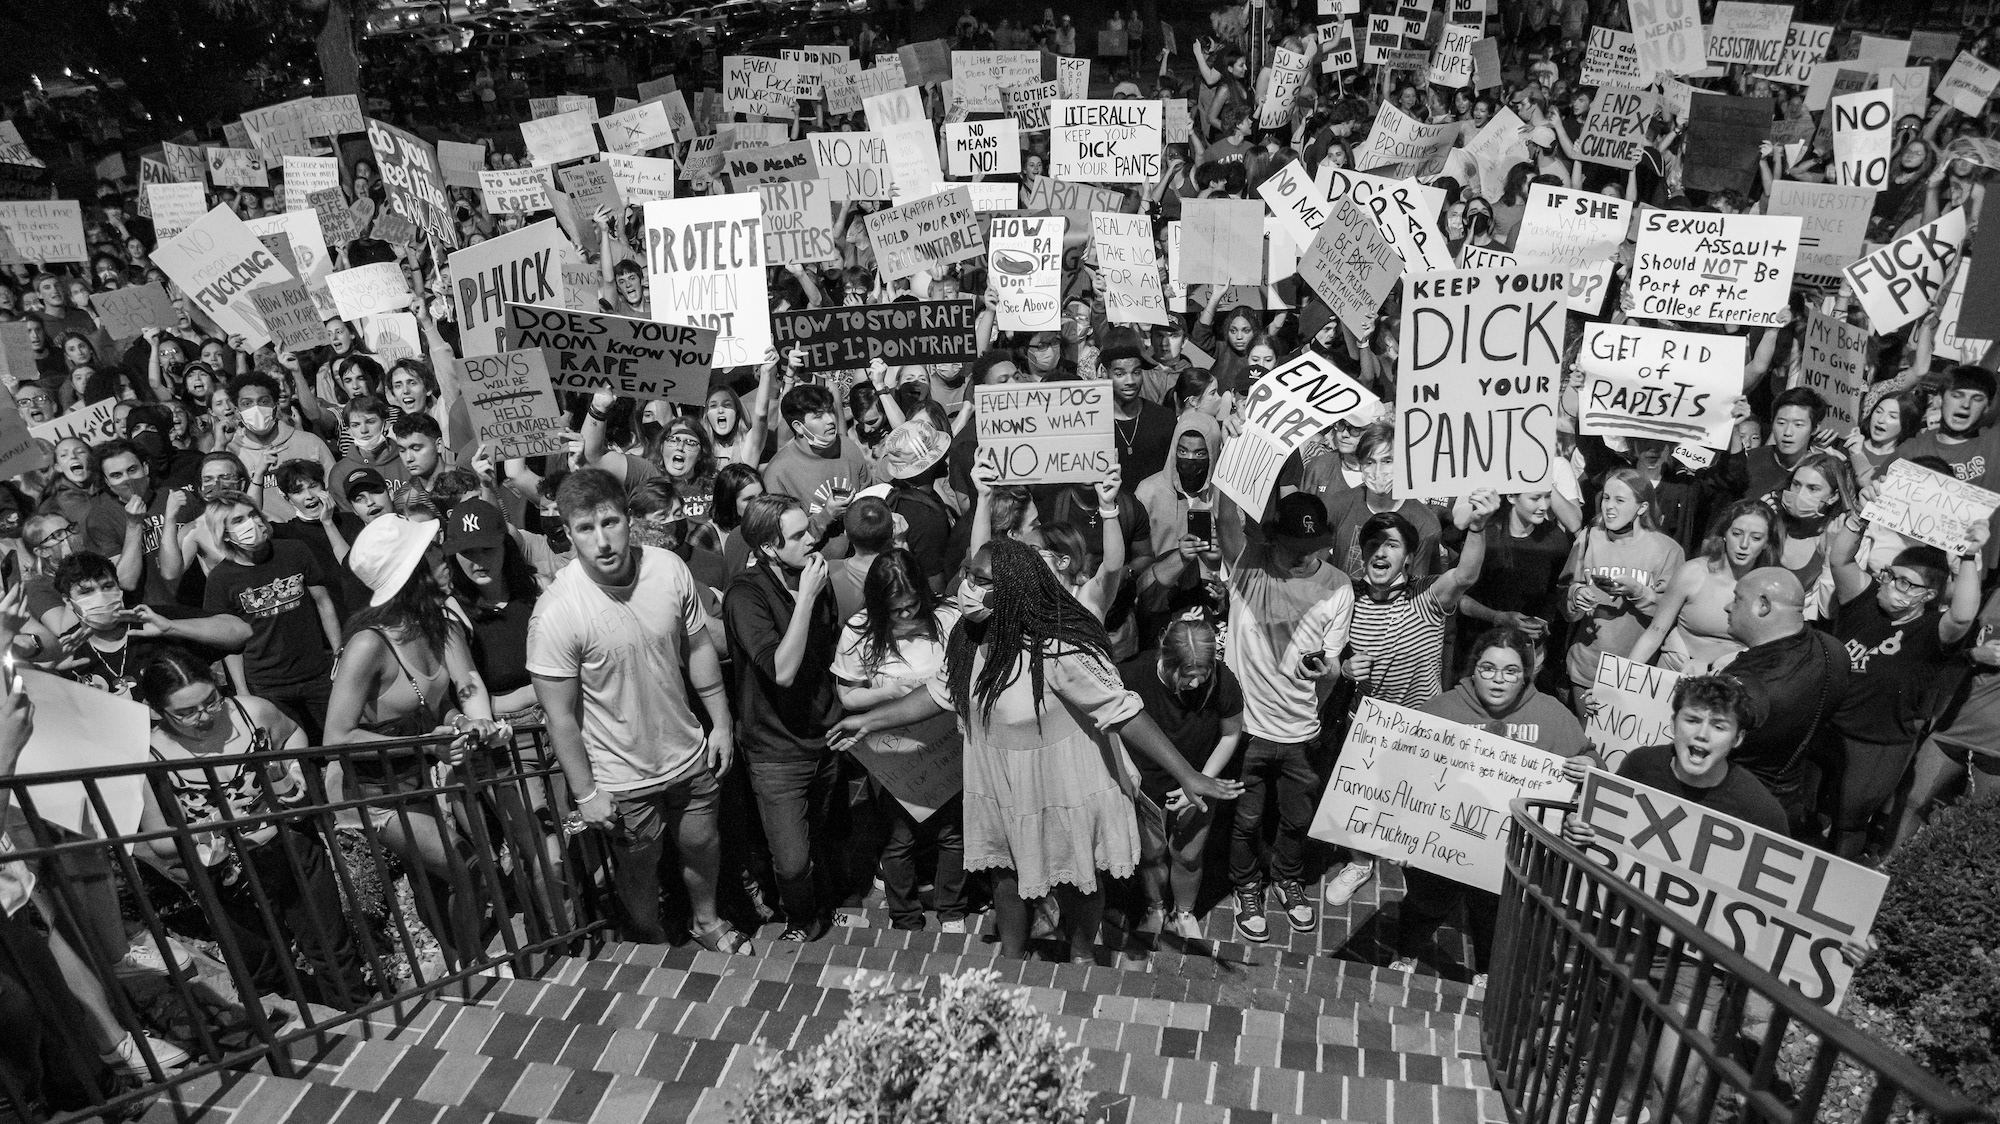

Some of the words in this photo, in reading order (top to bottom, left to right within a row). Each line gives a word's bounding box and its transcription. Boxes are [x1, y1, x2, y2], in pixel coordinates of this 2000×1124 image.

[1373, 19, 1389, 33] NO
[1405, 22, 1420, 35] NO
[1644, 17, 1692, 39] MEANS
[782, 51, 790, 61] IF
[1335, 52, 1352, 66] NO
[1709, 36, 1782, 63] RESISTANCE
[731, 70, 752, 87] MY
[743, 58, 777, 74] EVEN
[989, 66, 1007, 76] NOT
[1013, 84, 1057, 103] CLOTHES
[1601, 93, 1641, 116] END
[1064, 105, 1147, 126] LITERALLY
[1377, 103, 1402, 134] Hold
[1409, 124, 1444, 141] your
[1588, 114, 1630, 137] RAPE
[1836, 101, 1890, 132] NO
[968, 124, 984, 137] NO
[1064, 129, 1091, 142] KEEP
[1105, 127, 1137, 140] YOUR
[367, 119, 396, 154] do
[396, 135, 432, 173] you
[818, 138, 852, 167] NO
[957, 137, 998, 151] MEANS
[1079, 141, 1117, 160] DICK
[1581, 134, 1637, 161] CULTURE
[730, 160, 758, 177] NO
[969, 151, 998, 173] NO!
[1056, 163, 1071, 176] IN
[1077, 162, 1108, 175] YOUR
[1115, 154, 1160, 177] PANTS
[1842, 157, 1887, 187] NO
[375, 152, 413, 195] feel
[411, 168, 447, 213] like
[485, 179, 503, 188] TO
[509, 174, 547, 187] WEAR
[846, 168, 885, 198] NO!
[309, 189, 341, 206] Greek
[751, 178, 814, 216] STRIP
[901, 199, 936, 221] KAPPA
[938, 191, 958, 209] PSI
[1547, 193, 1568, 208] IF
[1575, 198, 1619, 220] SHE
[1781, 190, 1870, 211] UNIVERSITY
[25, 204, 48, 218] tell
[53, 208, 73, 218] me
[391, 193, 408, 217] a
[404, 193, 459, 250] MAN
[767, 212, 804, 230] YOUR
[1559, 213, 1598, 232] WAS
[324, 221, 350, 233] RAPE
[877, 229, 910, 248] HOLD
[917, 216, 950, 237] YOUR
[950, 209, 971, 227] BOYS
[991, 219, 1044, 238] HOW
[1096, 217, 1124, 237] REAL
[1127, 219, 1152, 238] MEN
[1336, 200, 1369, 241] BOYS
[1366, 232, 1392, 272] WILL
[1646, 213, 1725, 236] Sexual
[177, 228, 214, 261] NO
[648, 217, 761, 275] PROTECT
[888, 223, 982, 273] ACCOUNTABLE
[1097, 242, 1126, 262] TAKE
[1132, 248, 1155, 266] NO
[1315, 236, 1345, 274] SEXUAL
[1334, 233, 1352, 256] BE
[1552, 242, 1585, 256] WHY
[192, 250, 240, 286] means
[1640, 253, 1695, 272] Should
[1702, 258, 1747, 279] NOT
[1754, 263, 1779, 282] Be
[1846, 223, 1954, 295] FUCK
[195, 250, 275, 313] FUCKING
[458, 248, 555, 331] PHUCK
[1101, 267, 1133, 285] FOR
[1140, 272, 1160, 290] AN
[1414, 276, 1480, 299] KEEP
[1495, 273, 1563, 295] YOUR
[1639, 277, 1680, 294] Part
[1689, 283, 1709, 298] of
[1717, 284, 1747, 300] the
[255, 294, 282, 316] HOW
[340, 294, 376, 314] NO
[671, 273, 738, 311] WOMEN
[1109, 295, 1165, 310] ANSWER
[264, 312, 294, 332] DON'T
[294, 305, 322, 325] RAPE
[1003, 300, 1020, 313] See
[1022, 298, 1055, 313] Above
[1643, 295, 1701, 318] College
[512, 306, 608, 334] DOES
[629, 320, 697, 345] YOUR
[775, 313, 832, 341] HOW
[836, 311, 865, 332] TO
[866, 308, 916, 331] STOP
[920, 305, 974, 330] RAPE
[1413, 300, 1560, 370] DICK
[1810, 318, 1832, 344] MY
[276, 326, 314, 347] PEOPLE!
[518, 330, 598, 351] MOM
[606, 339, 671, 359] KNOW
[673, 349, 712, 368] YOU
[929, 334, 977, 356] RAPE
[1590, 330, 1641, 361] GET
[1663, 340, 1711, 363] RID
[464, 353, 529, 382] BOYS
[560, 352, 639, 378] RAPE
[1638, 363, 1670, 380] of
[1810, 346, 1825, 363] To
[1829, 353, 1857, 375] Give
[483, 379, 511, 390] WILL
[512, 376, 528, 386] BE
[1275, 360, 1361, 415] END
[1413, 383, 1440, 403] IN
[1478, 376, 1549, 396] YOUR
[1804, 368, 1830, 392] NOT
[493, 404, 533, 422] HELD
[981, 393, 1025, 415] EVEN
[1027, 391, 1052, 413] MY
[1060, 387, 1102, 407] DOG
[480, 416, 561, 441] ACCOUNTABLE
[980, 416, 1037, 435] KNOWS
[1047, 410, 1099, 430] WHAT
[1245, 383, 1323, 448] RAPE
[494, 438, 561, 461] ACTIONS
[1404, 403, 1552, 489] PANTS
[1675, 446, 1707, 464] causes
[986, 443, 1039, 481] NO
[1044, 449, 1109, 475] MEANS
[1216, 433, 1284, 509] CULTURE
[1921, 471, 1962, 494] NO
[1885, 478, 1975, 523] MEANS
[1899, 506, 1935, 536] NO
[1597, 651, 1661, 700] EVEN
[1380, 736, 1388, 748] is
[1419, 748, 1430, 759] so
[1433, 753, 1448, 765] we
[1478, 765, 1495, 778] get
[1433, 732, 1440, 742] a
[1442, 729, 1455, 747] lot
[1459, 738, 1471, 751] of
[1473, 742, 1496, 760] fuck
[1499, 749, 1517, 765] shit
[1521, 754, 1539, 771] but
[1333, 765, 1391, 804] Famous
[1439, 805, 1451, 821] is
[1452, 801, 1500, 836] NOT
[1345, 805, 1373, 834] For
[1370, 811, 1420, 855] Fucking
[1421, 830, 1474, 866] Rape
[1581, 771, 1855, 937] EXPEL
